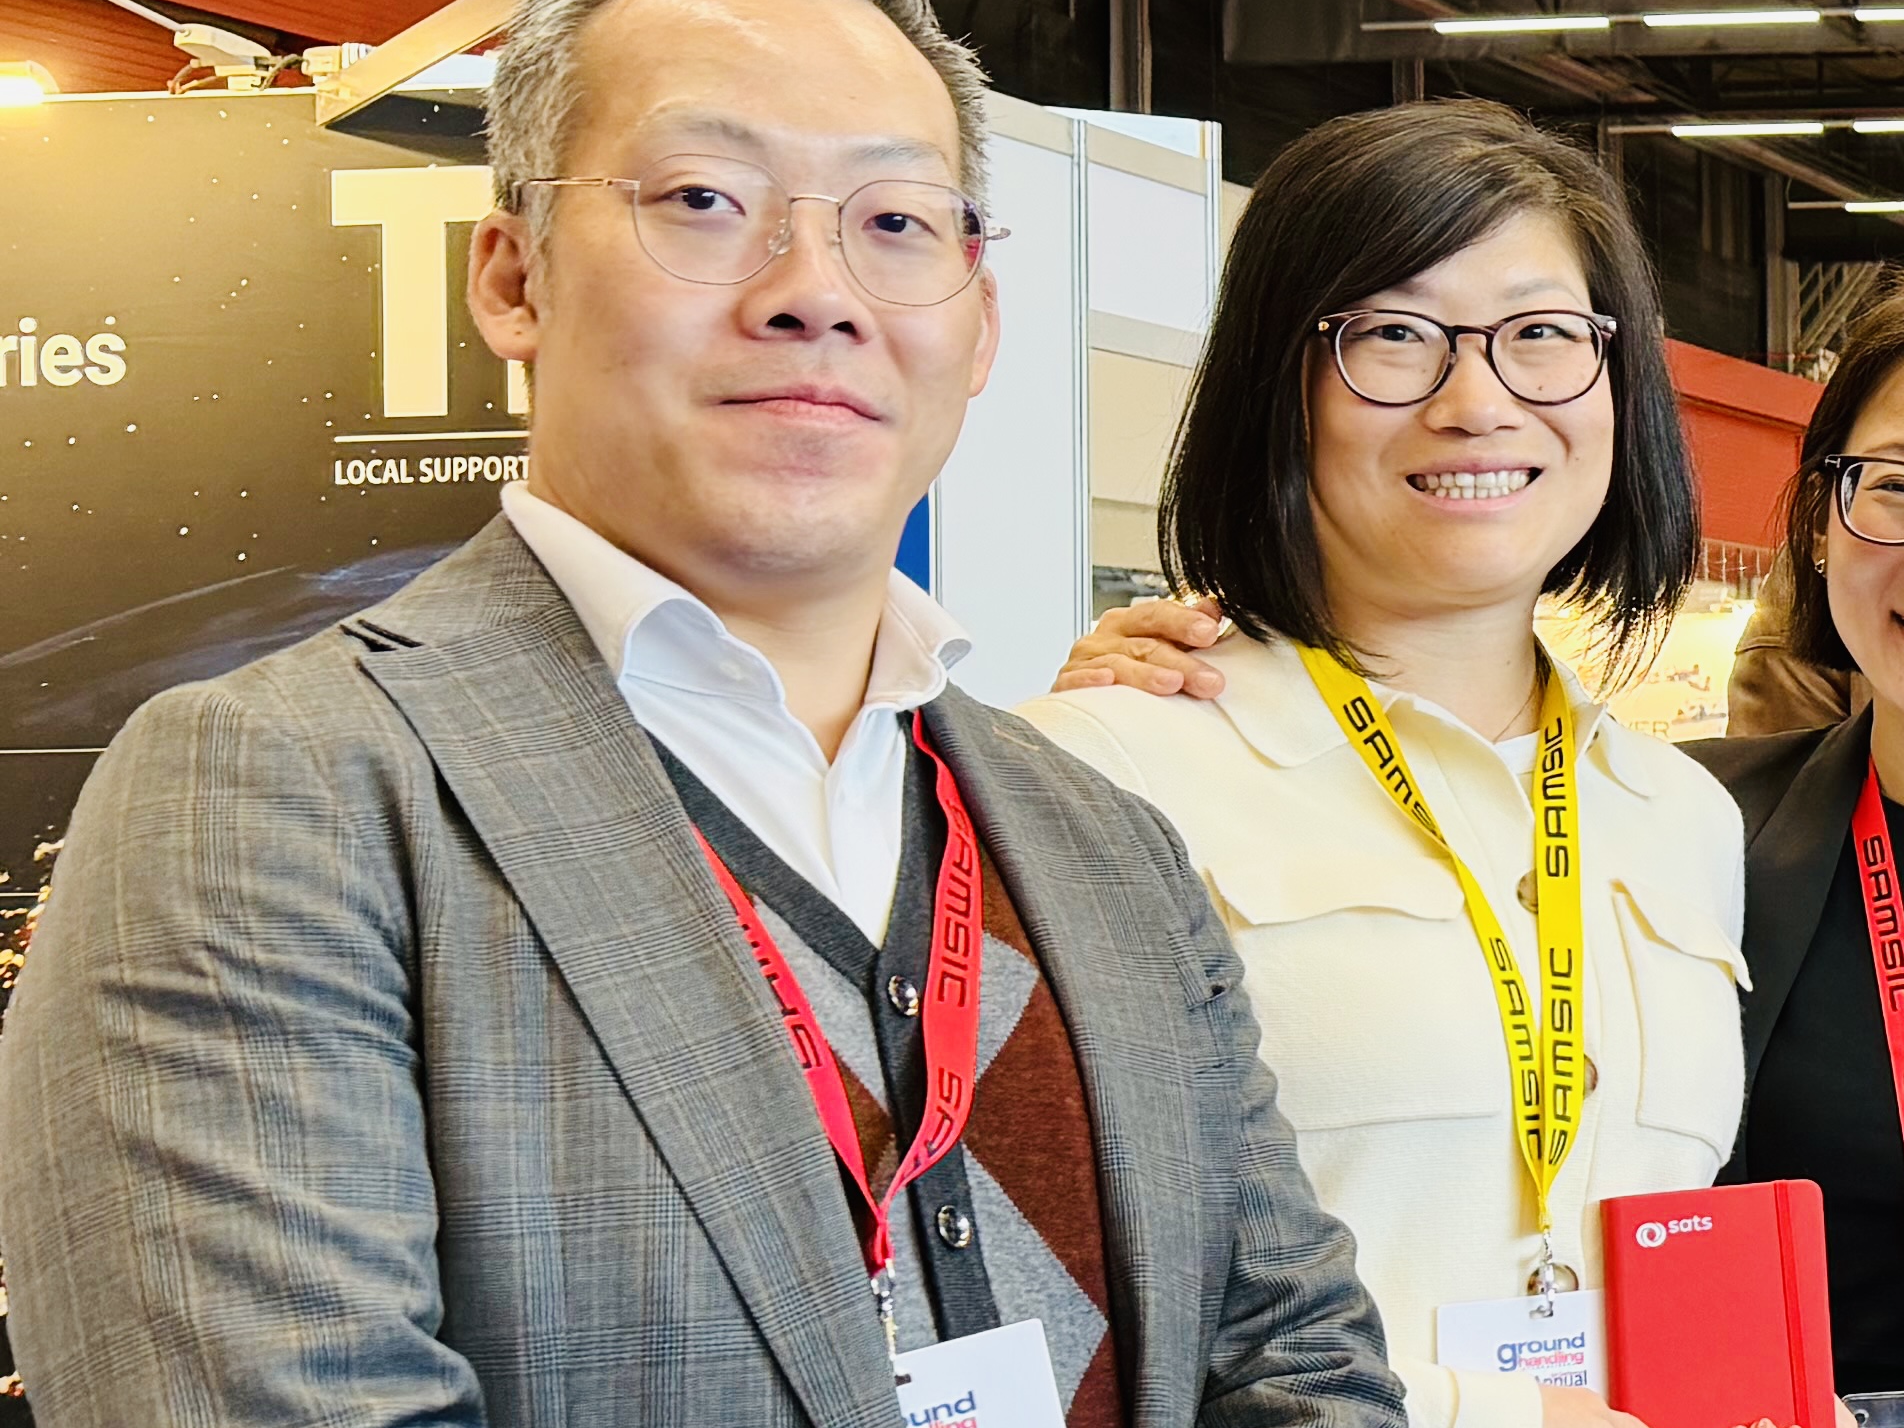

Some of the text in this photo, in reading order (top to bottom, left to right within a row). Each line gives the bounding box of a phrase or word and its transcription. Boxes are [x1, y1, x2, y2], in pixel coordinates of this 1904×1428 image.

[0, 315, 128, 387] ries
[335, 455, 530, 486] LOCAL SUPPORT
[1343, 696, 1438, 834] SAMS
[1540, 716, 1569, 878] SAMSIC
[1489, 936, 1543, 1161] SAMSIC
[1548, 948, 1573, 1167] SAMSIC
[1668, 1215, 1713, 1234] sats
[1497, 1331, 1585, 1372] ground
[1535, 1370, 1588, 1387] nnual
